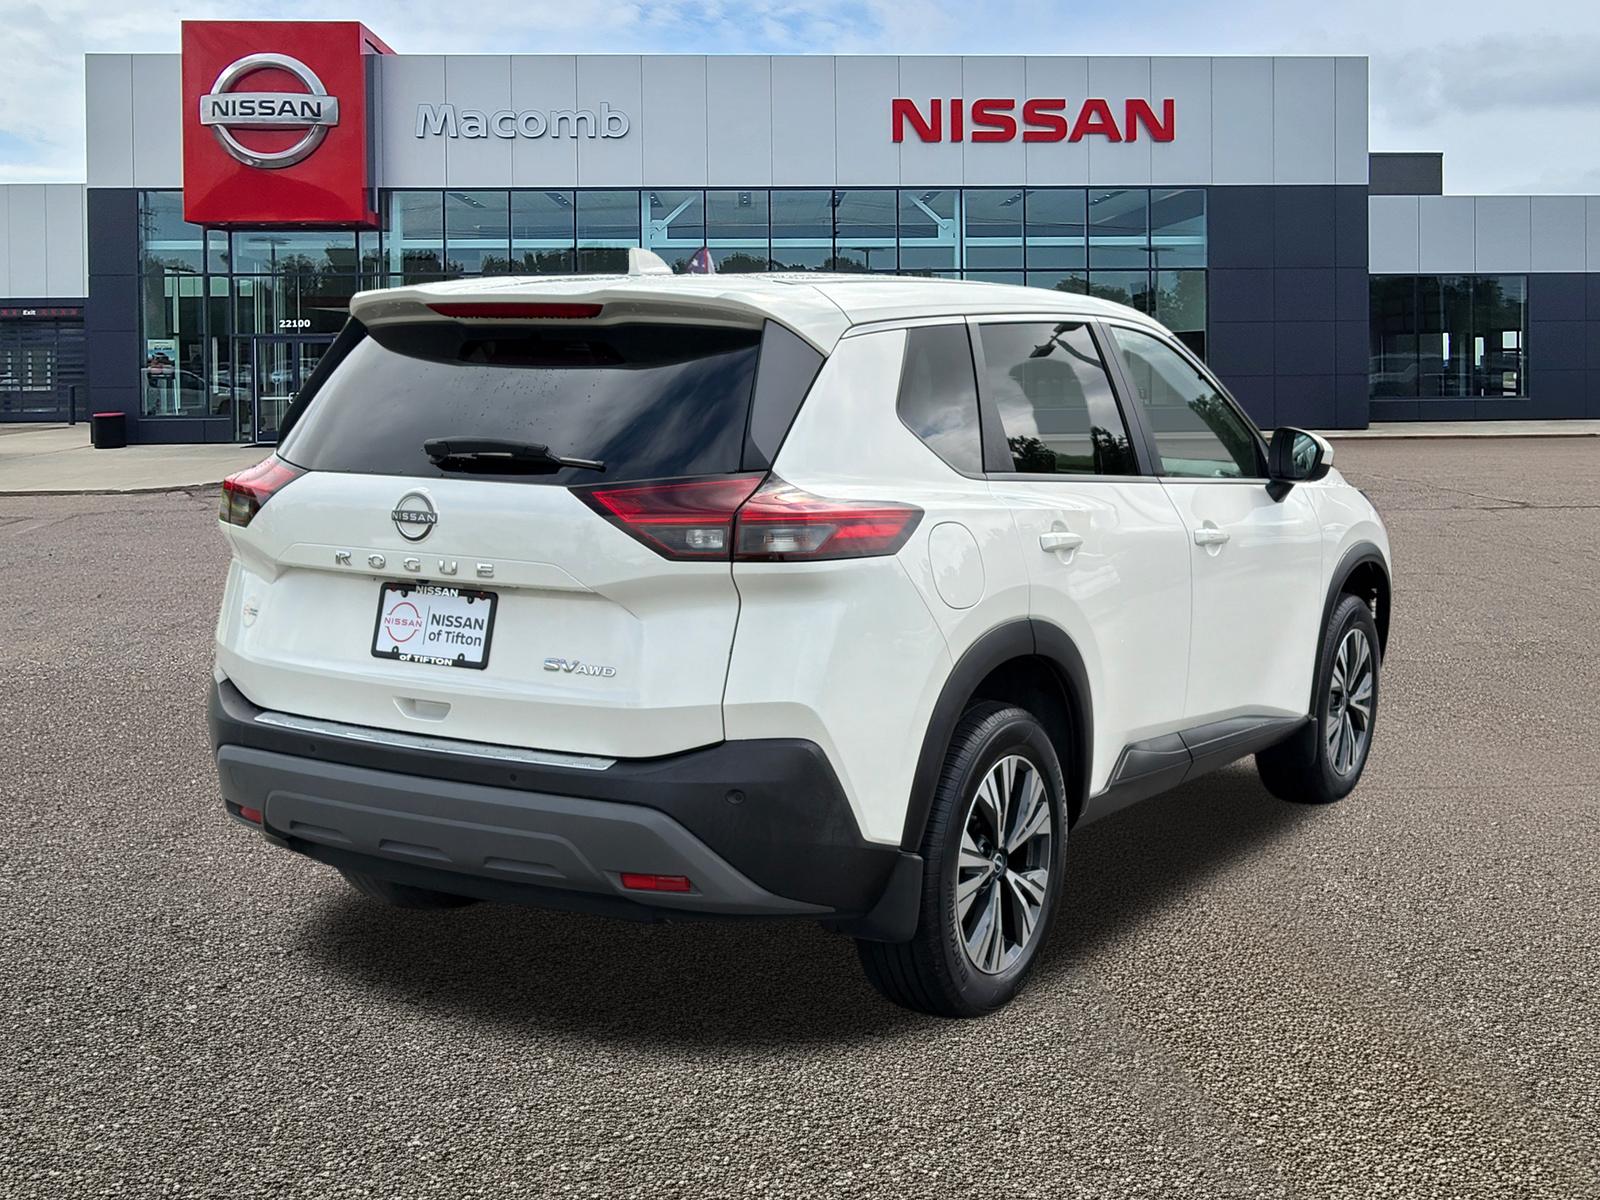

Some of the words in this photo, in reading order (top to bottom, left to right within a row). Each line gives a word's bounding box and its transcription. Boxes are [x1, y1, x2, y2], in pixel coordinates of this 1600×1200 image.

[212, 100, 322, 118] NISSAN
[415, 102, 630, 139] Macomb
[892, 98, 1175, 143] NISSAN
[279, 319, 311, 328] 22100
[392, 510, 436, 523] NISSAN
[335, 550, 494, 578] ROGUE
[415, 585, 459, 597] NISSAN
[384, 616, 422, 627] NISSAN
[430, 613, 484, 631] NISSAN
[428, 629, 442, 642] of
[445, 630, 482, 647] Tifton
[399, 653, 412, 661] of
[413, 654, 453, 666] TIFTON
